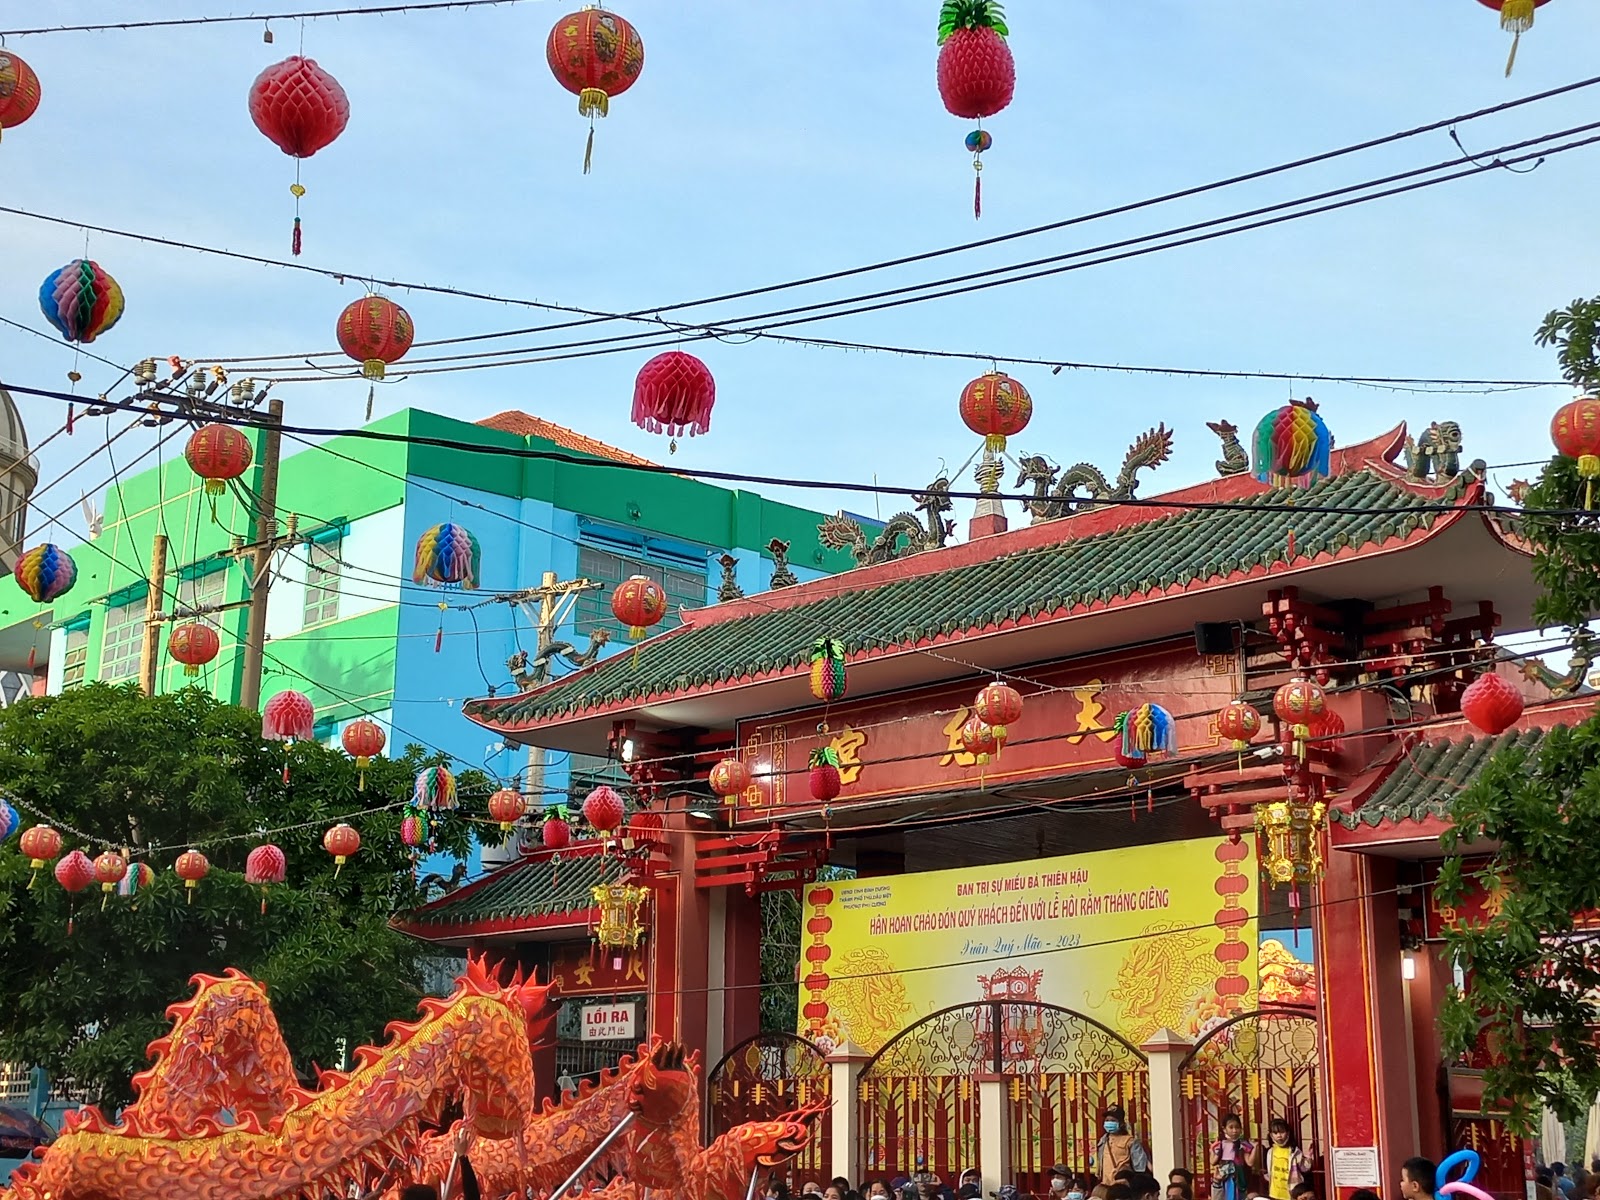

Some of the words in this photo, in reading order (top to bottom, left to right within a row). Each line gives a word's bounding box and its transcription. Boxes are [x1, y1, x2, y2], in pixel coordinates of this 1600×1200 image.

[956, 883, 975, 896] BAN
[976, 882, 990, 897] TRỊ
[991, 878, 1003, 897] SỰ
[1004, 871, 1026, 891] MIẾU
[1028, 872, 1039, 888] BÀ
[1041, 870, 1068, 887] THIÊN
[1070, 867, 1089, 888] HẬU
[869, 913, 887, 935] HÂN
[889, 915, 912, 933] HOAN
[913, 909, 937, 932] CHÀO
[938, 907, 956, 929] ĐÓN
[958, 904, 976, 928] QUÝ
[977, 902, 1008, 926] KHÁCH
[1009, 896, 1029, 923] ĐẾN
[1030, 896, 1046, 921] VỚI
[1048, 891, 1060, 919] LỄ
[1080, 888, 1101, 916] RẰM
[1103, 888, 1137, 913] THÁNG
[1138, 885, 1169, 911] GIÊNG
[960, 938, 989, 955] Xuân
[1016, 932, 1042, 950] Mão
[1055, 933, 1082, 948] 2023
[586, 1007, 607, 1025] LỐI
[610, 1010, 629, 1023] RA
